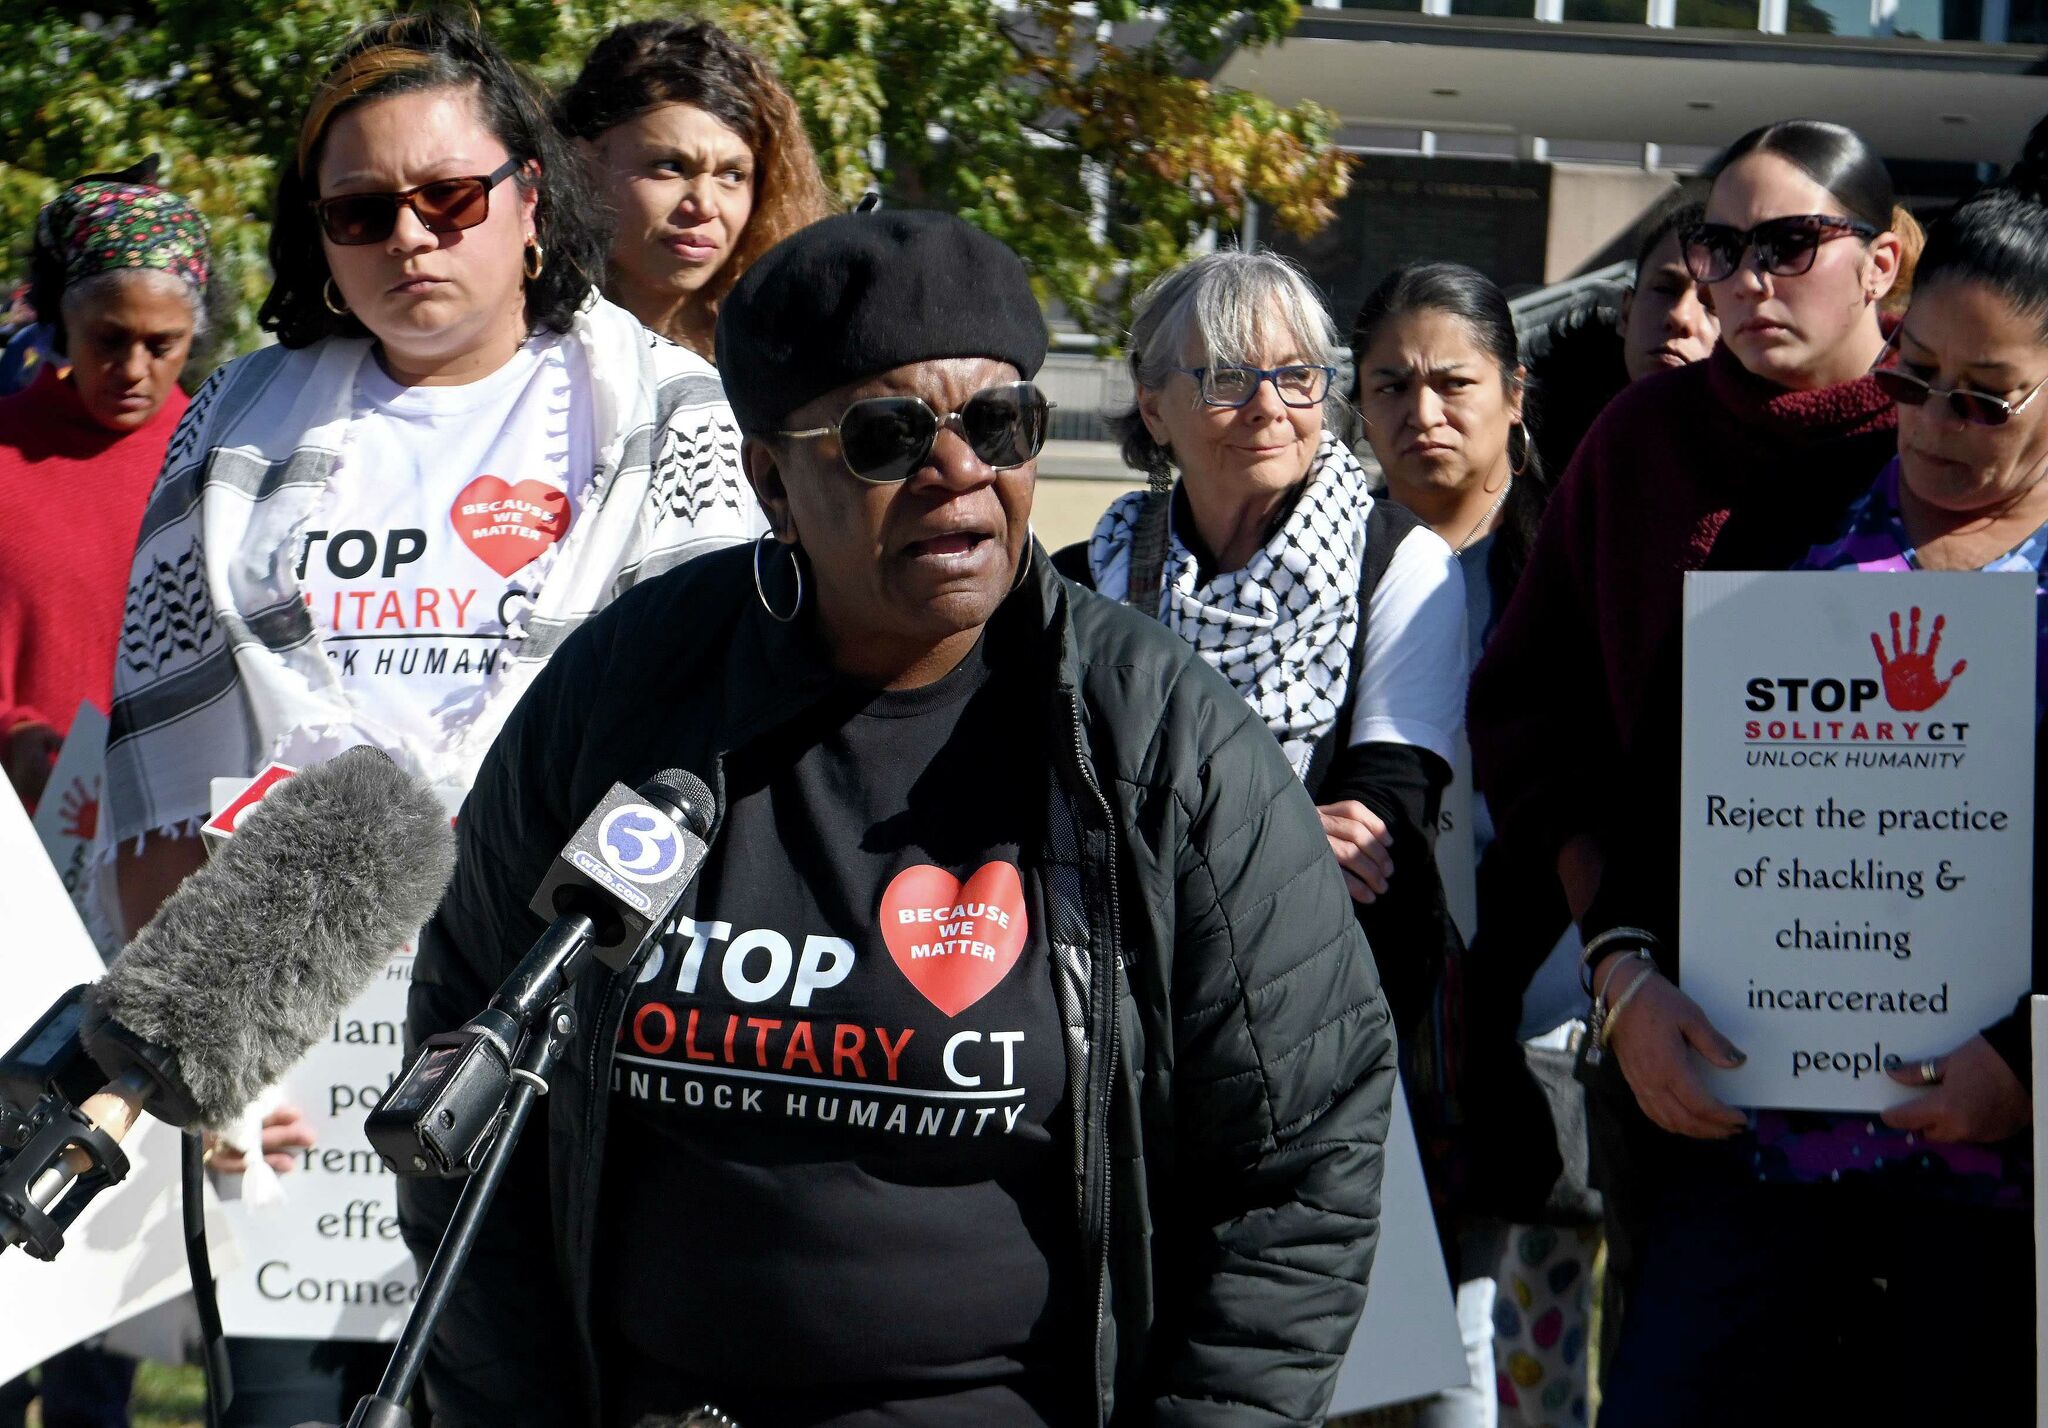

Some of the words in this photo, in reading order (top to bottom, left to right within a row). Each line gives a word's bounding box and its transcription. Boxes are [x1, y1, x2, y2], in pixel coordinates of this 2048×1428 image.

[462, 499, 556, 521] BECAUSE
[494, 512, 523, 523] WE
[472, 524, 542, 541] MATTER
[1745, 677, 1879, 712] STOP
[1746, 750, 1838, 768] UNLOCK
[1845, 751, 1966, 768] HUMANITY
[1706, 795, 1805, 833] Reject
[1815, 797, 1866, 829] the
[1878, 800, 2009, 836] practice
[603, 808, 680, 874] 3
[581, 855, 646, 906] wfsb.com
[1734, 856, 1771, 888] of
[1777, 857, 1924, 898] shackling
[1935, 859, 1966, 891] &
[897, 902, 1010, 930] BECAUSE
[939, 921, 974, 937] WE
[910, 939, 997, 962] MATTER
[1775, 918, 1912, 959] chaining
[1747, 979, 1949, 1013] incarcerated
[616, 1001, 916, 1081] OLITARY
[942, 1030, 1026, 1087] CT
[786, 1093, 1026, 1137] HUMANITY
